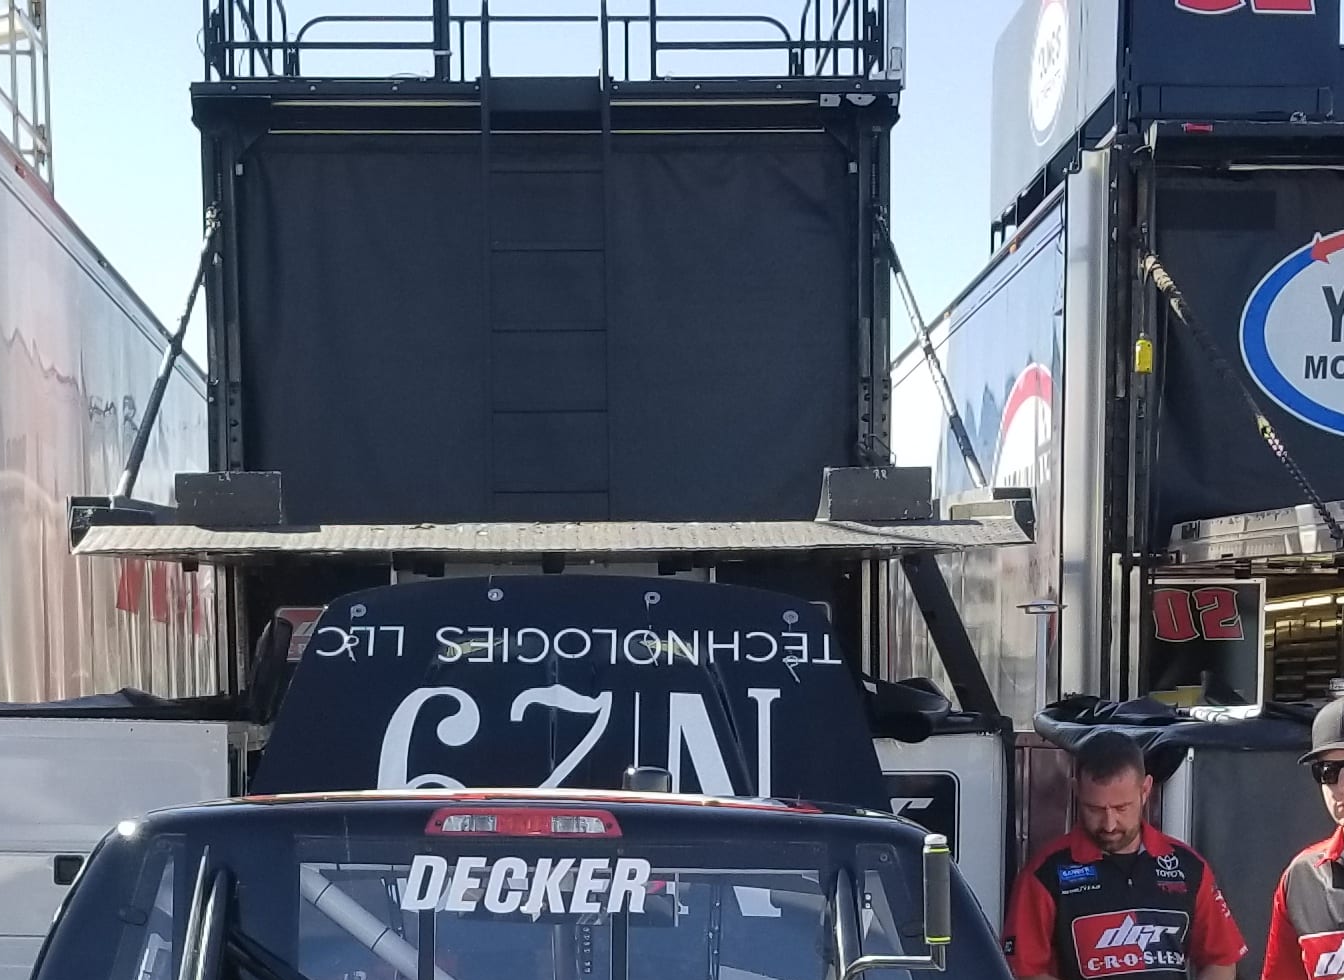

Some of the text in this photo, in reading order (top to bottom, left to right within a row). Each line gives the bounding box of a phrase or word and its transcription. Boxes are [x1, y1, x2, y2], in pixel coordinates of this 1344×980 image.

[1152, 586, 1245, 643] 02
[315, 625, 843, 667] TECHNOLOGIES LLC
[401, 855, 651, 914] DECKER
